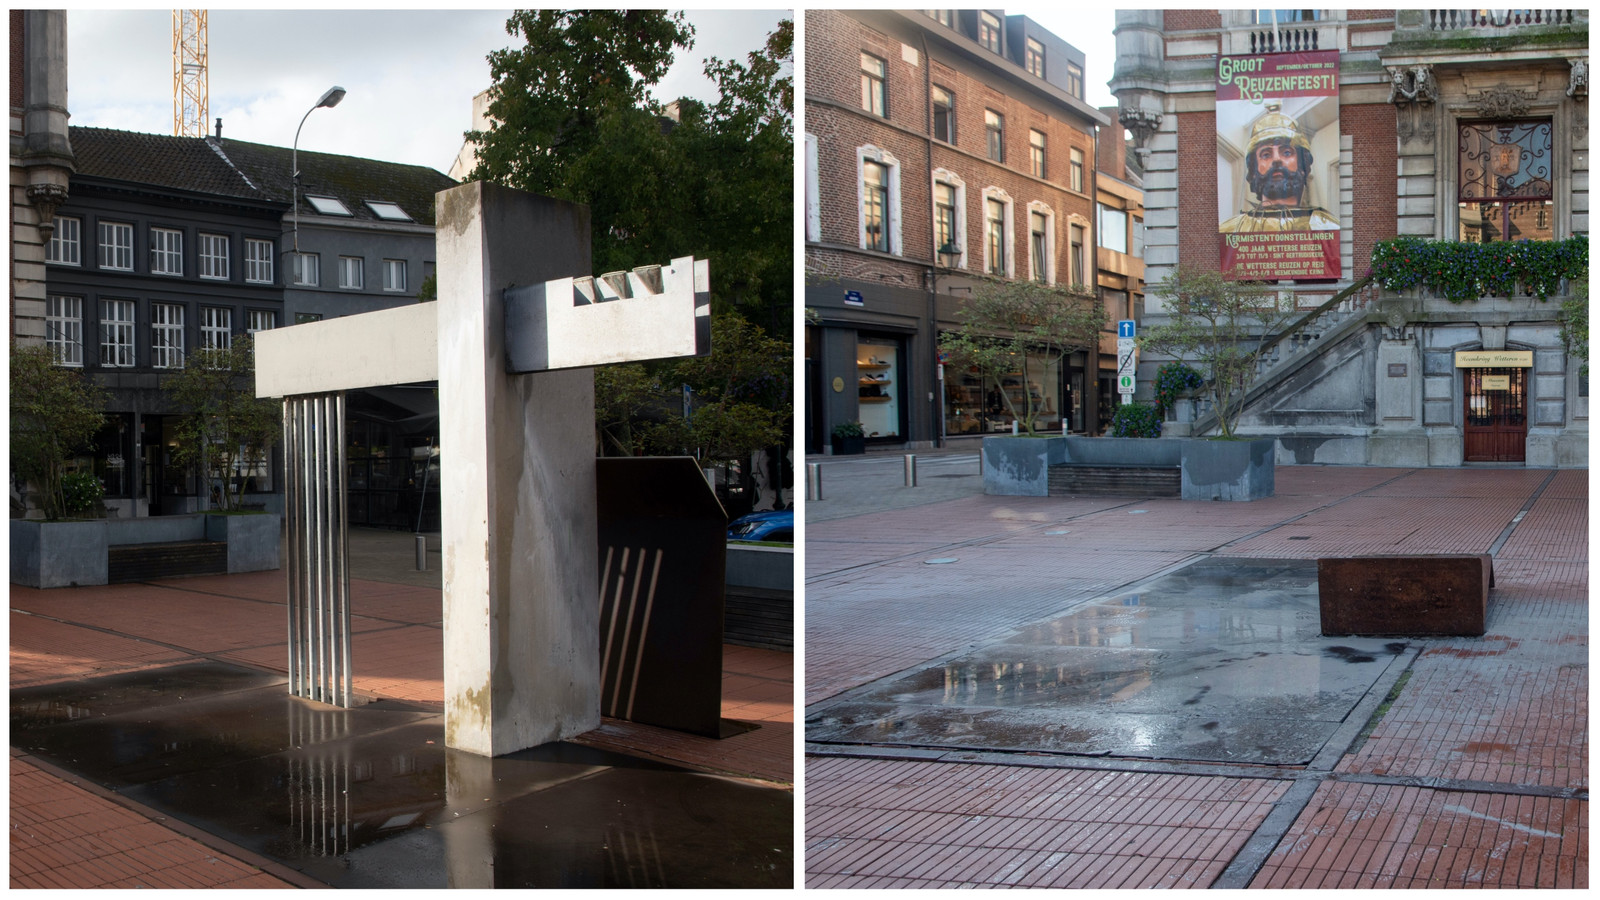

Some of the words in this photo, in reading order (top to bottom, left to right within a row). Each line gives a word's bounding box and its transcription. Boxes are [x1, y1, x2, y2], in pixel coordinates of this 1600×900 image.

[1219, 57, 1265, 85] GROOT
[1234, 74, 1335, 104] REUZENFEEST!
[1226, 233, 1334, 248] KERMISTENTOONSTELLINGEN
